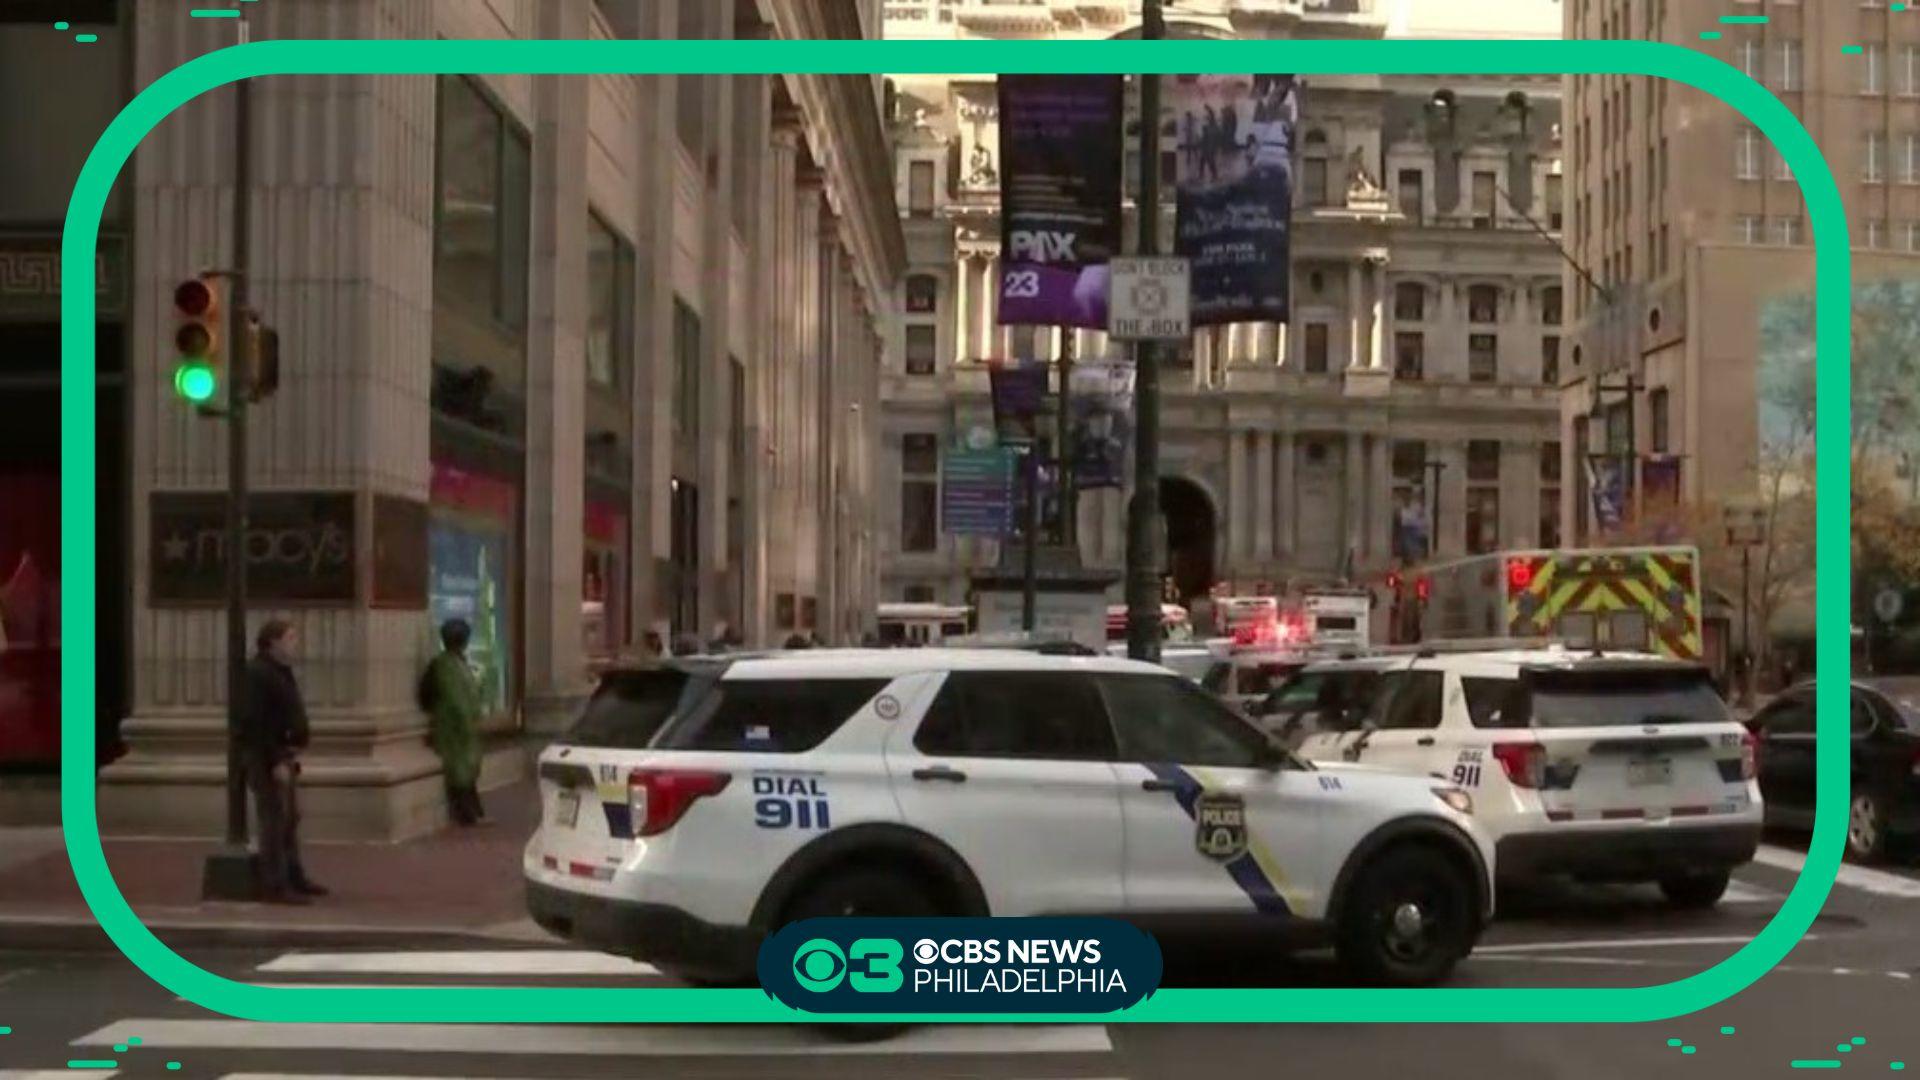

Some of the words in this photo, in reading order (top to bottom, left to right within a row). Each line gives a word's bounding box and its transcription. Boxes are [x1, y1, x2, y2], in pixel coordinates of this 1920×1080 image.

[1010, 230, 1076, 262] PAX
[1005, 270, 1039, 298] 23
[1116, 319, 1141, 336] THE
[1151, 319, 1184, 336] BOX
[753, 776, 828, 796] DIAL
[1452, 764, 1481, 787] 911
[755, 798, 830, 829] 911
[1202, 807, 1241, 826] POLICE
